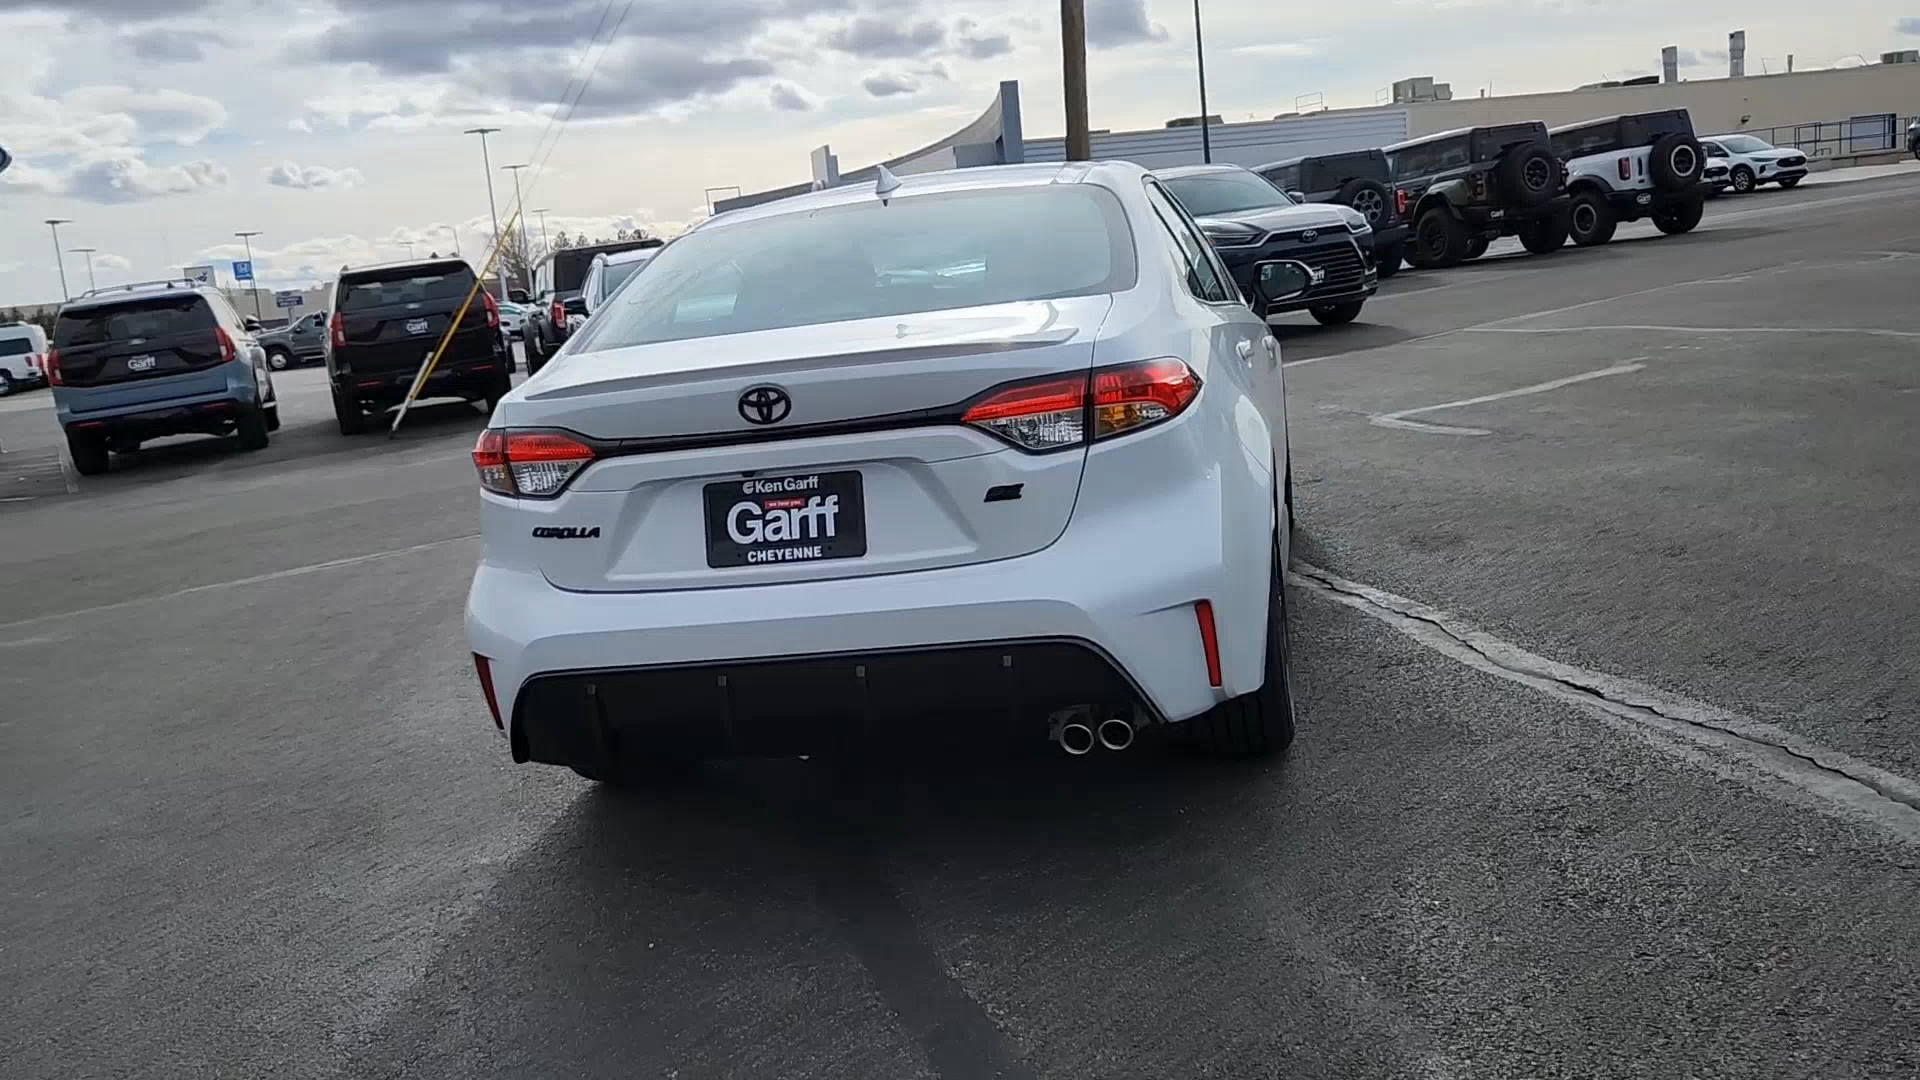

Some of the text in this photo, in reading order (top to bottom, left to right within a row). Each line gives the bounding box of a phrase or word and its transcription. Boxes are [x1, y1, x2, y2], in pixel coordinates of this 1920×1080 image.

[755, 475, 819, 494] Ken Garff
[727, 494, 839, 544] Garff
[532, 526, 601, 539] COROLLA
[747, 545, 822, 563] CHEYENNE
